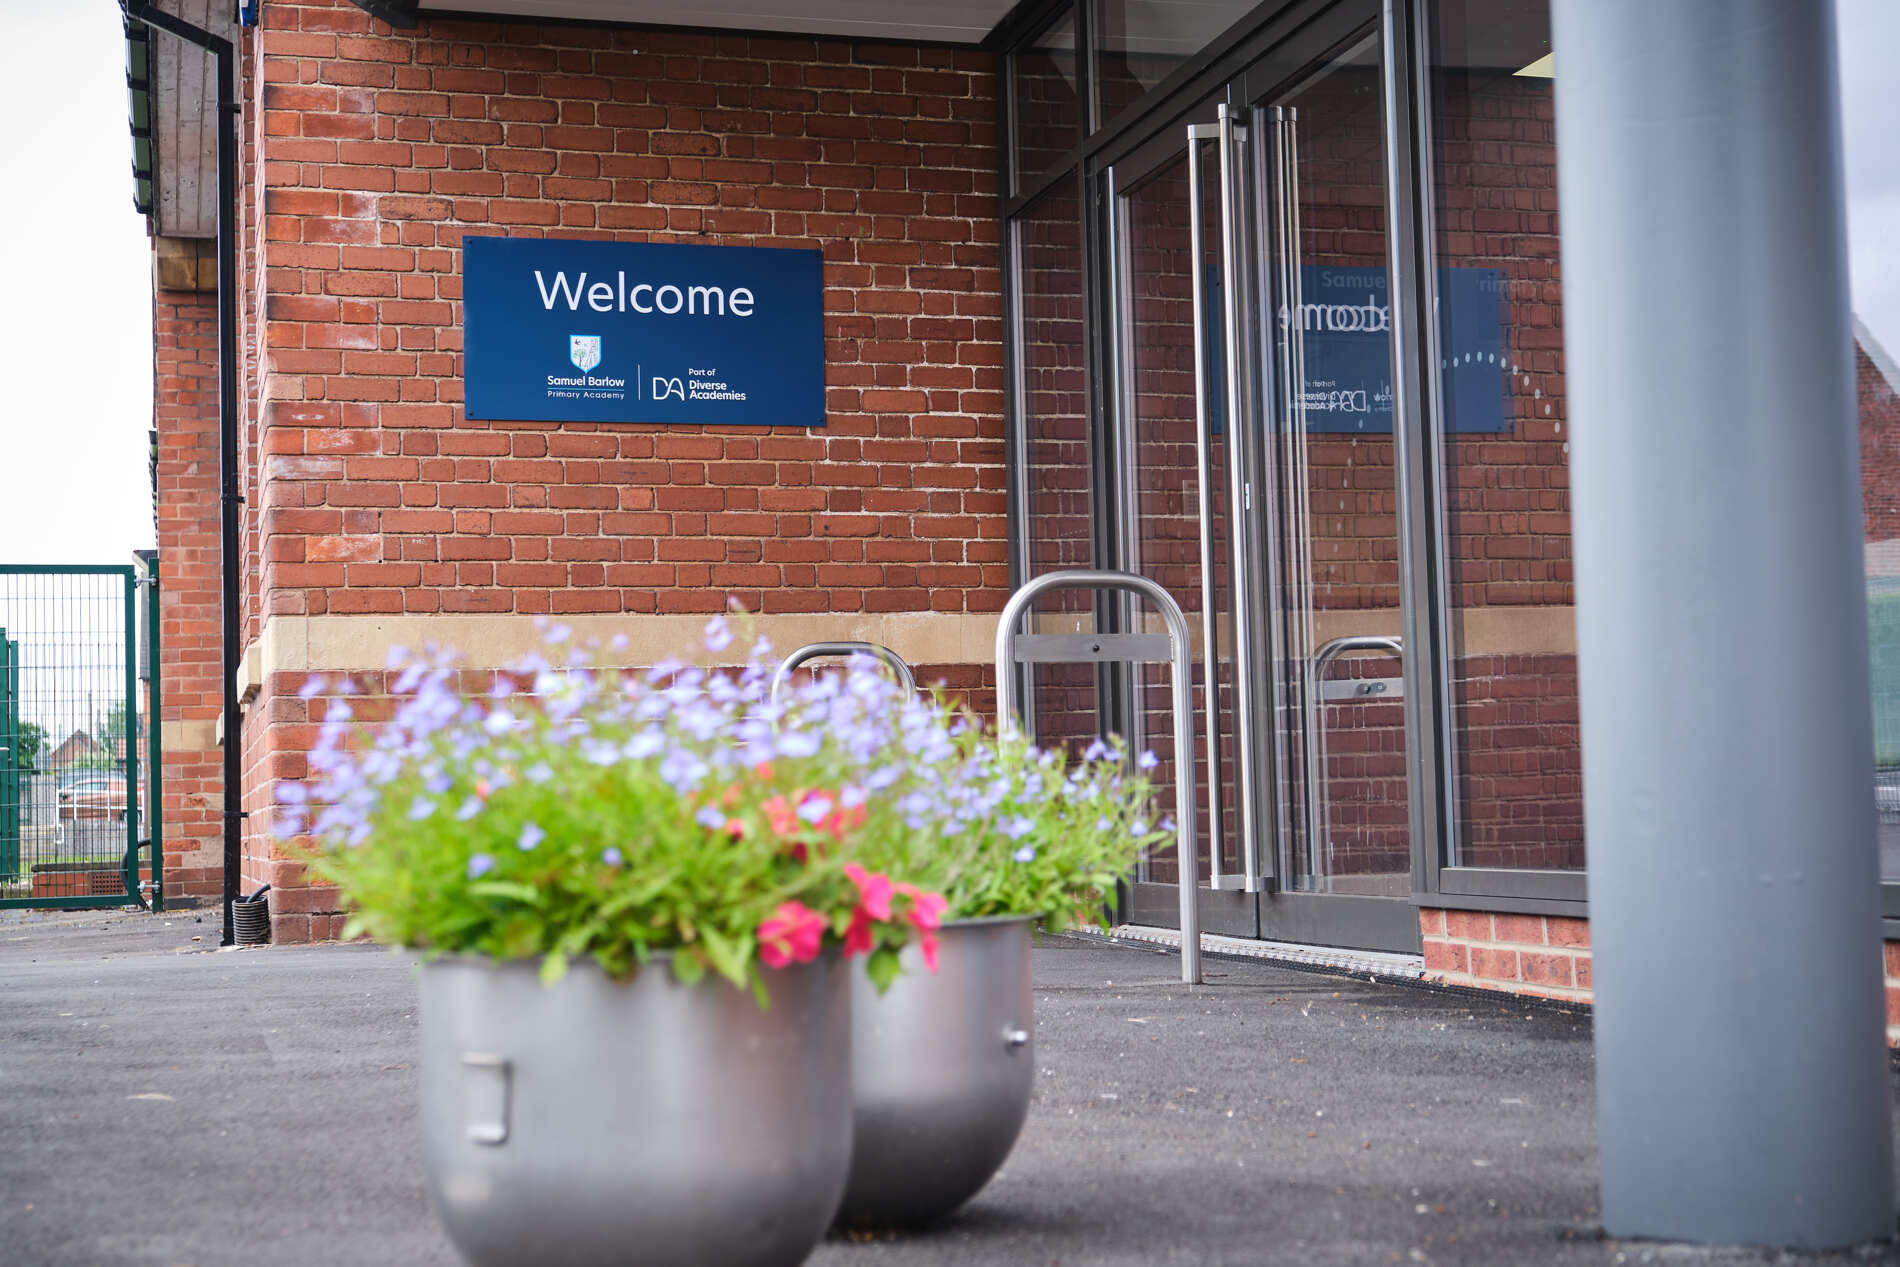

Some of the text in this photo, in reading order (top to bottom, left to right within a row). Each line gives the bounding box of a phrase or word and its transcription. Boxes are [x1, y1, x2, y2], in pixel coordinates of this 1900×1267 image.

[1321, 271, 1386, 290] Samue
[534, 270, 755, 317] Welcome
[688, 368, 717, 377] Part of
[547, 375, 625, 388] Samuel Barlow
[689, 380, 727, 391] Diverse
[547, 390, 625, 400] Primary Academy
[689, 390, 747, 401] Academies
